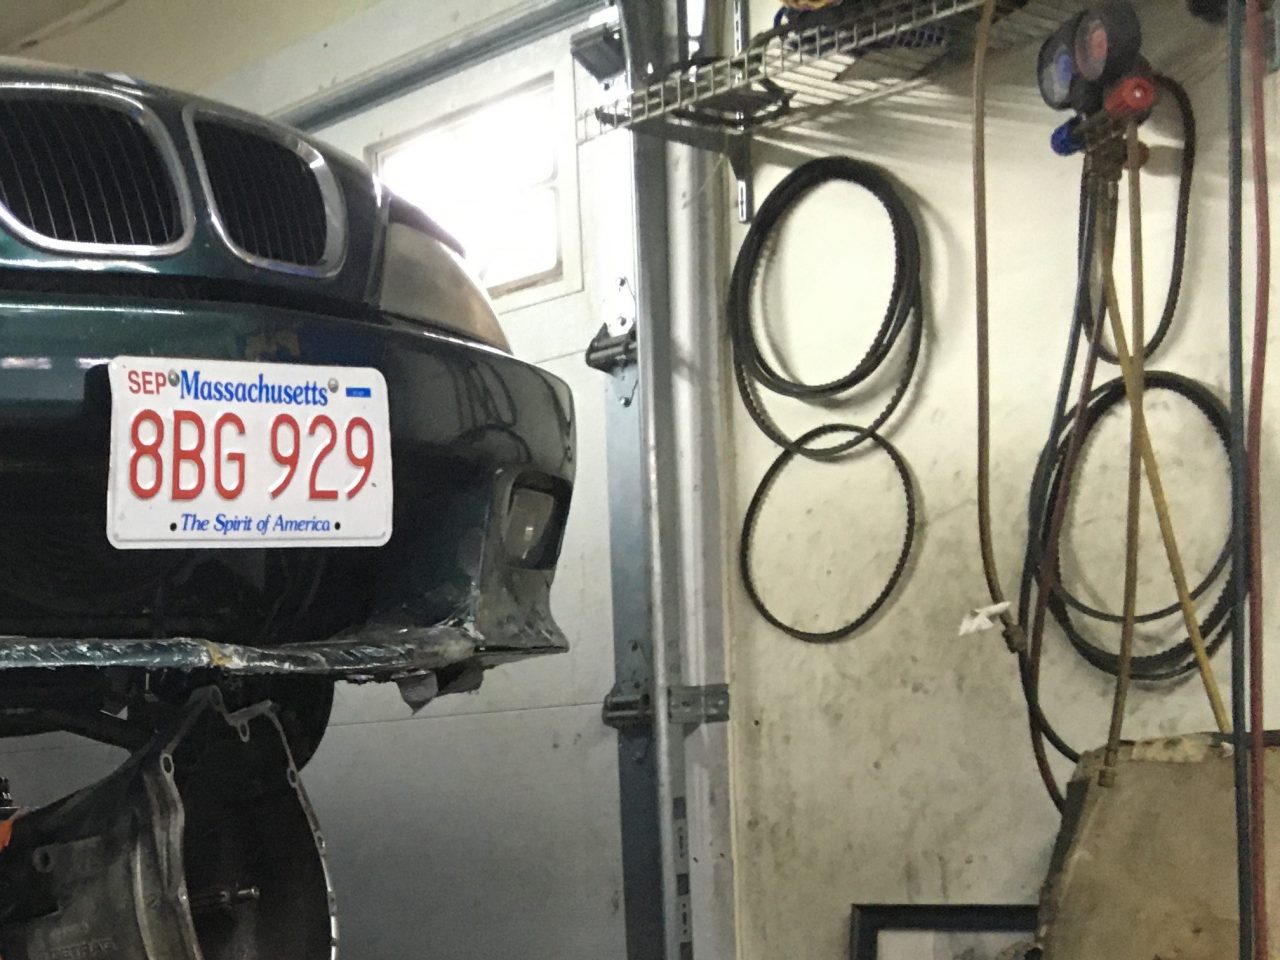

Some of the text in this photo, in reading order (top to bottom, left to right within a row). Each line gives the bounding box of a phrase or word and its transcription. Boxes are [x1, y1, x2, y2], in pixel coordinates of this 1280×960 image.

[128, 370, 329, 407] SEP Massachusetts
[129, 408, 374, 500] 8BG 929
[181, 513, 331, 536] The Spirit of America
